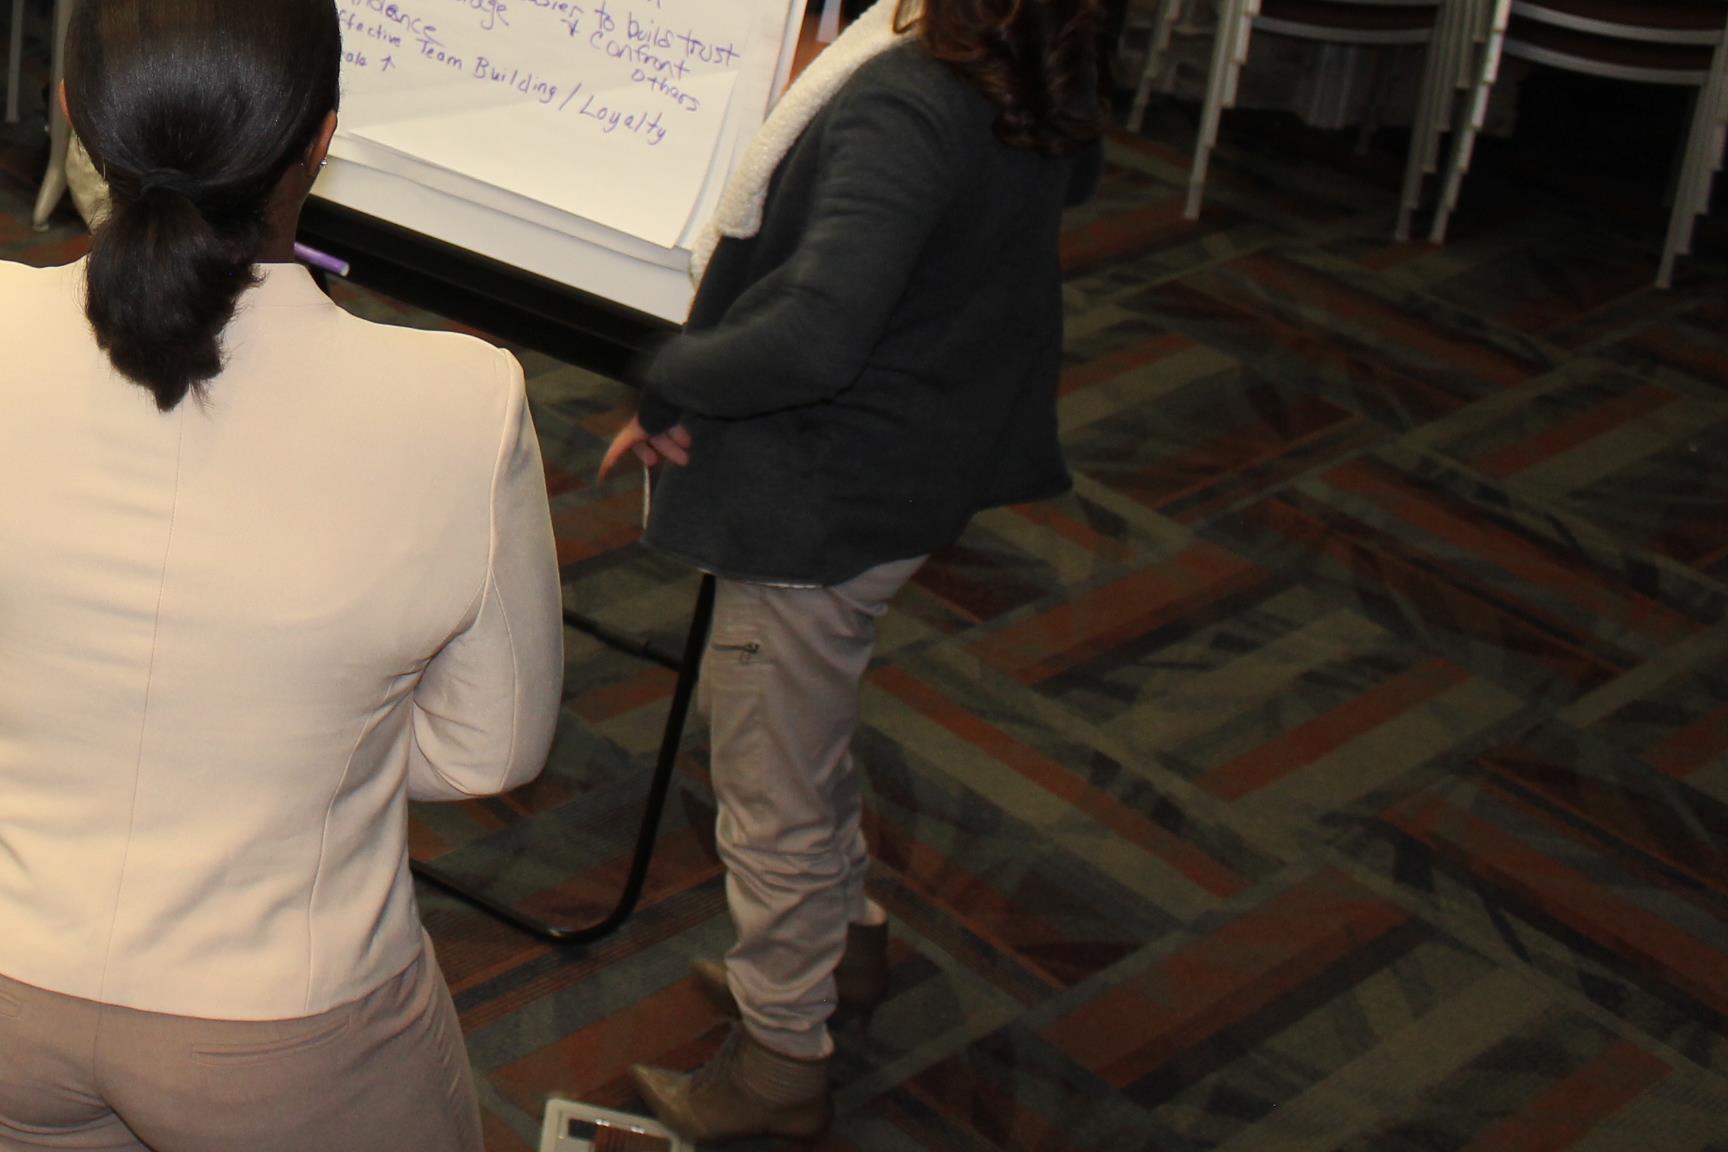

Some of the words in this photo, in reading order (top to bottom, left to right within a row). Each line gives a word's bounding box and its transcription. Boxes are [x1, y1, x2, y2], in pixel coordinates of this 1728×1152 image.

[594, 0, 615, 33] to
[628, 11, 675, 48] build
[677, 30, 740, 66] trust
[416, 38, 462, 70] Team
[472, 56, 557, 103] Building
[579, 95, 667, 145] Loyalty
